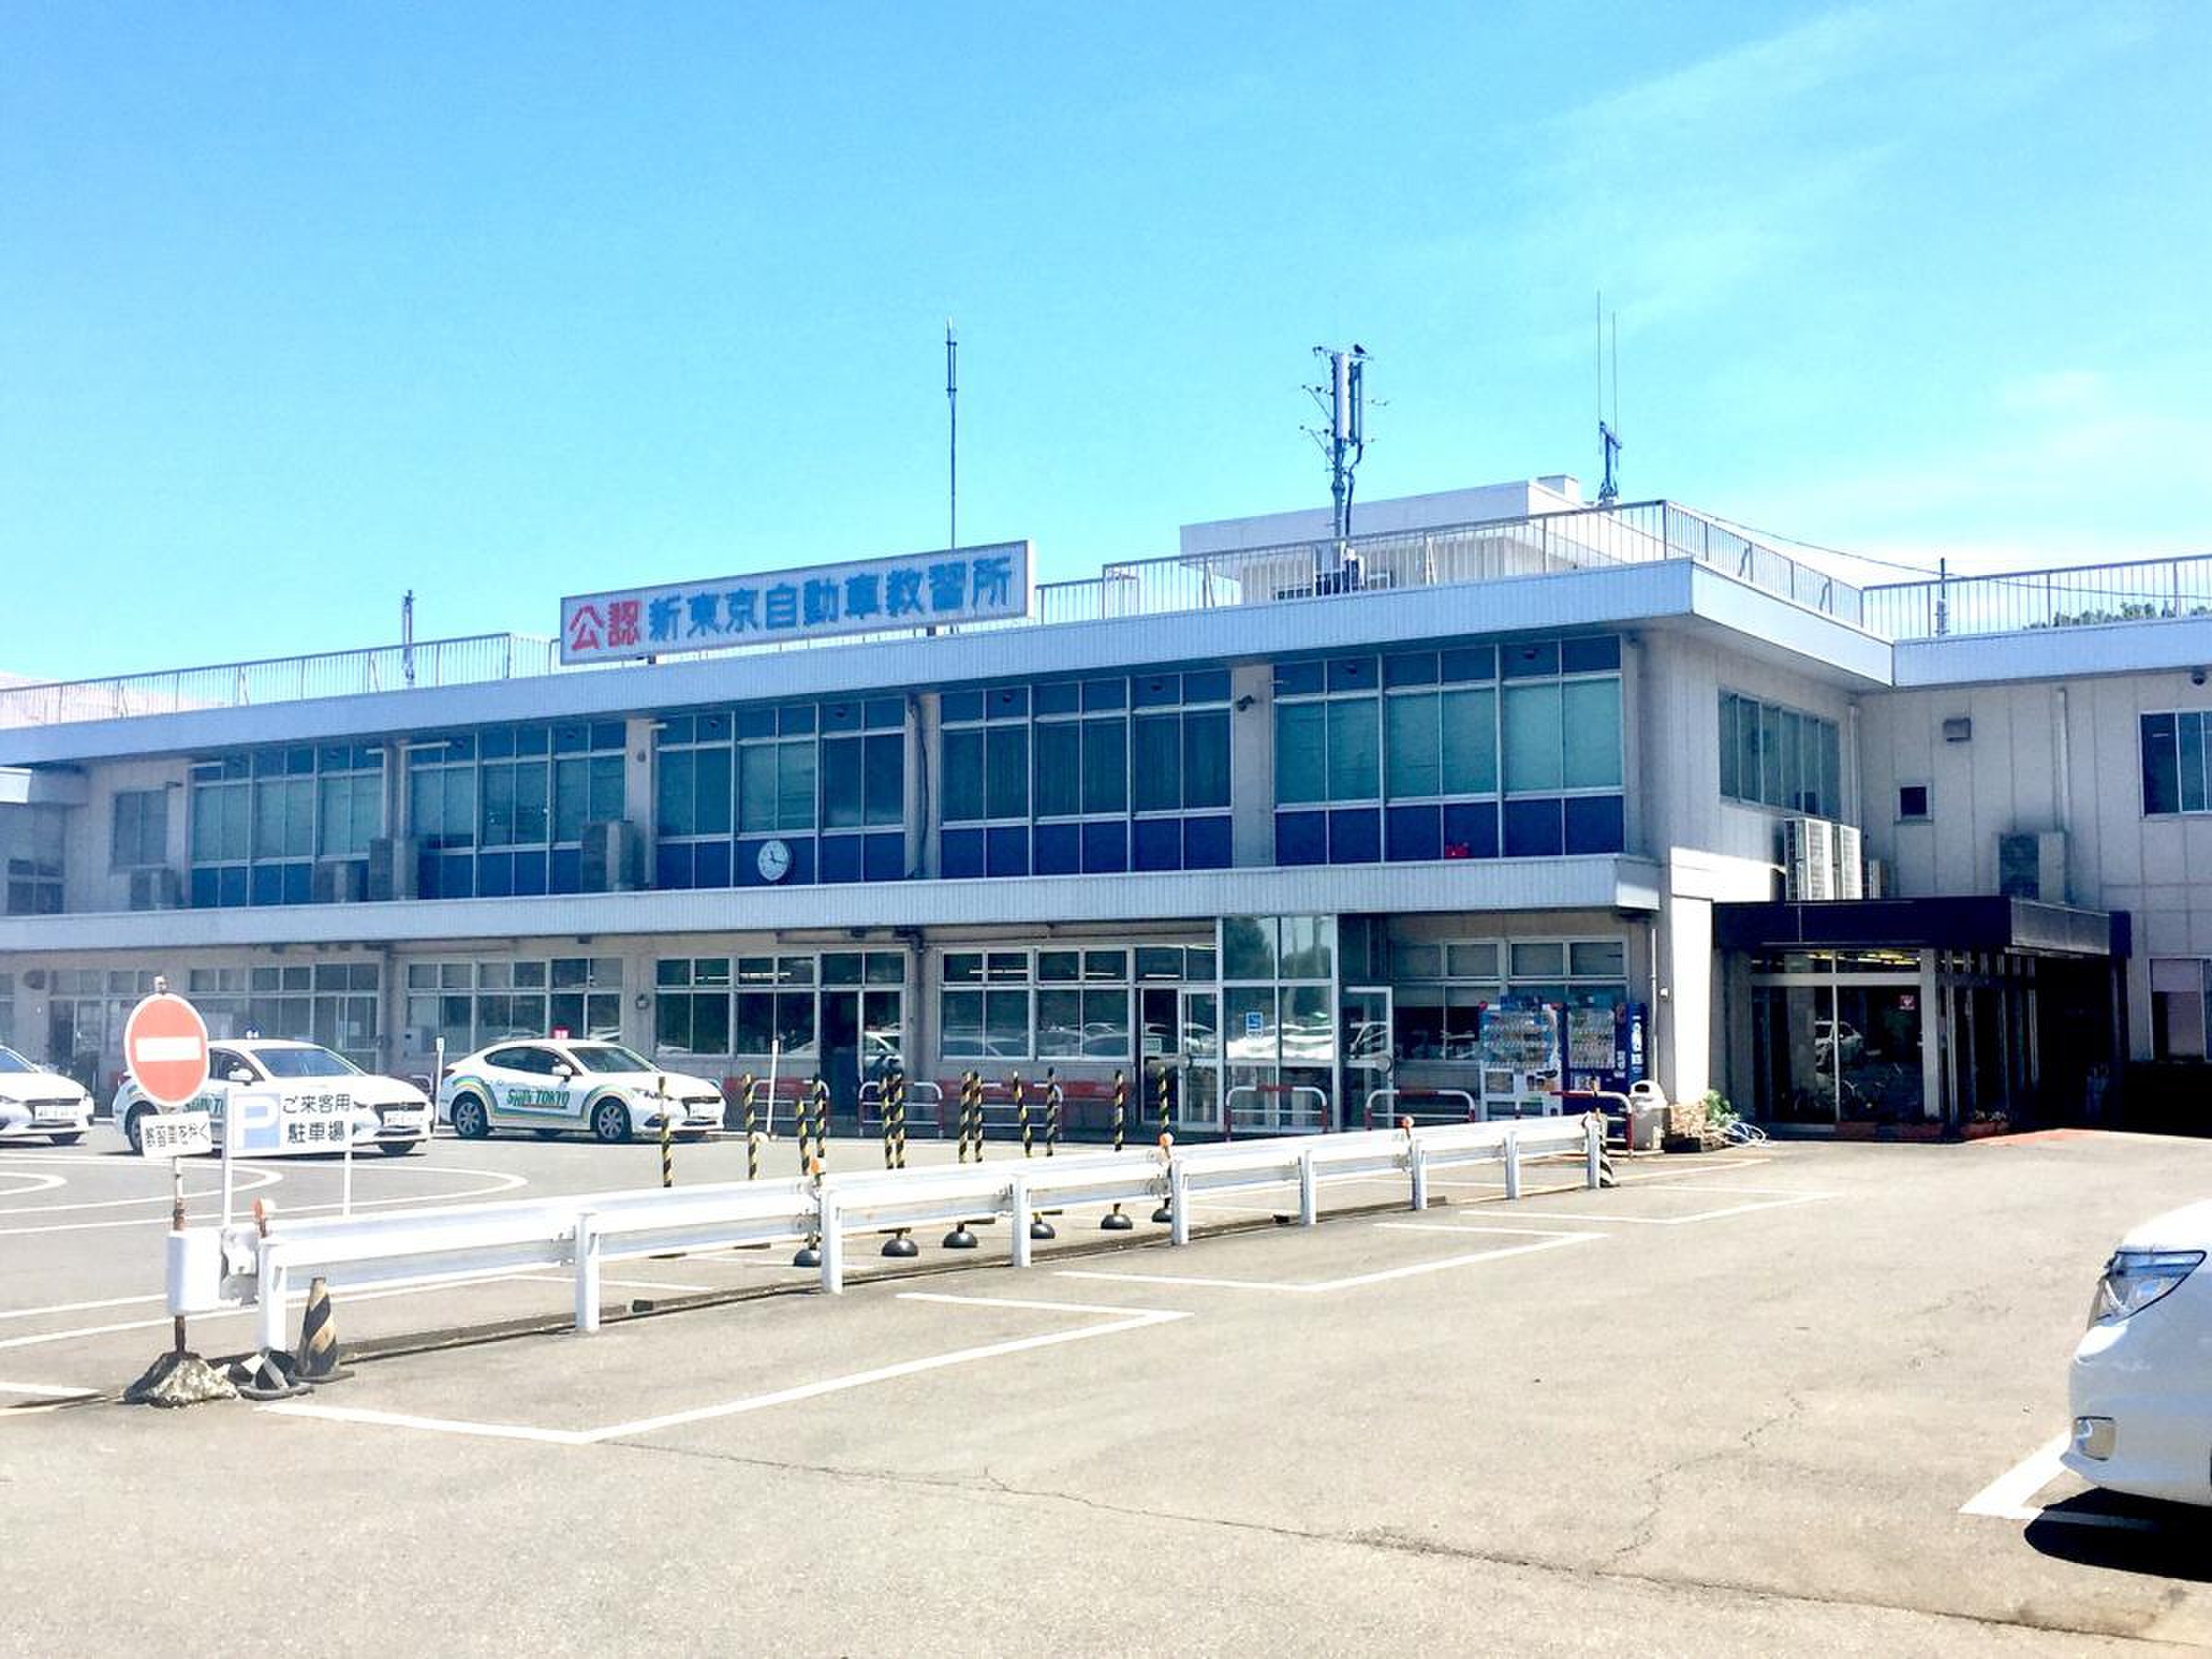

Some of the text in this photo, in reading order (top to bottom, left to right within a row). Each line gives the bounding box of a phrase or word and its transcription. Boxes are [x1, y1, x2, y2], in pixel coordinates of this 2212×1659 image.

[282, 1093, 351, 1114] ご来客用
[287, 1120, 346, 1144] 駐車場
